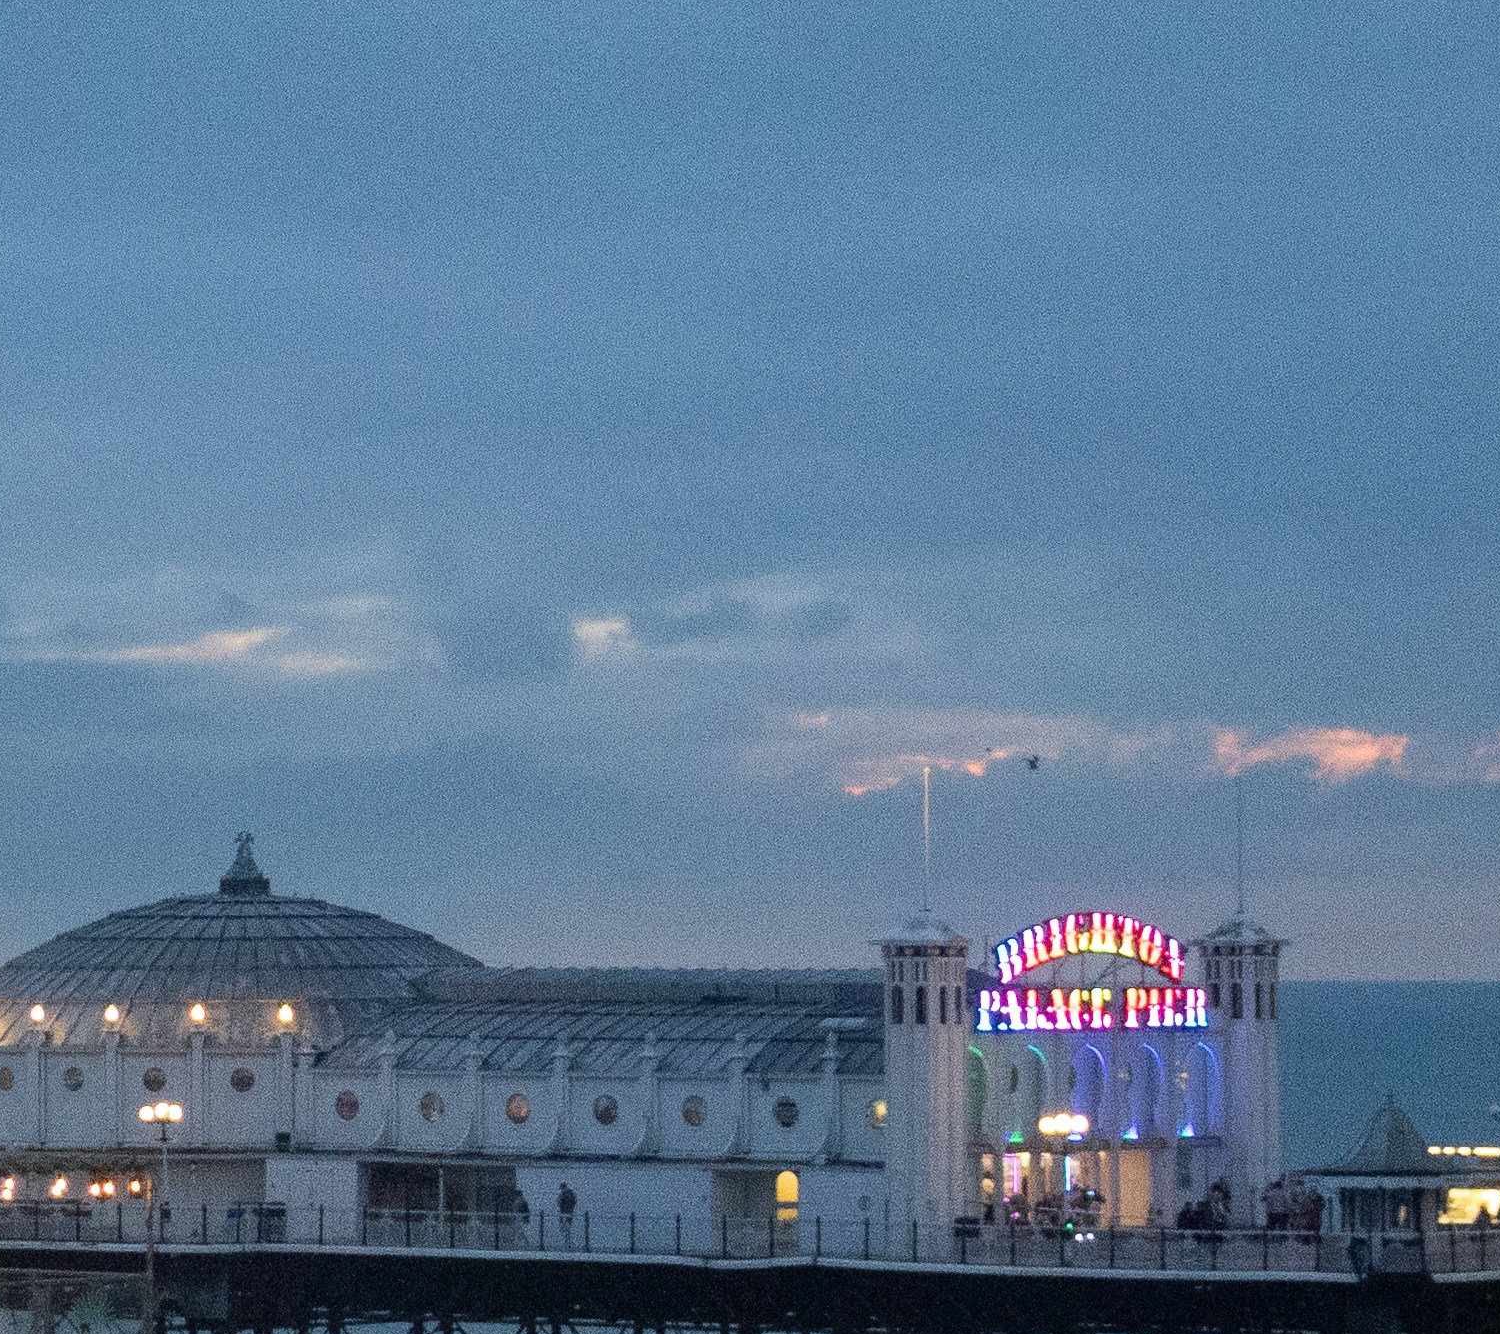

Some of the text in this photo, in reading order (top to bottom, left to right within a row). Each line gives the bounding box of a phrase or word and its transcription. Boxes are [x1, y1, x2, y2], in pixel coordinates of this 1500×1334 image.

[997, 911, 1187, 985] BRIGHTON
[977, 987, 1209, 1033] PALACE PIER
